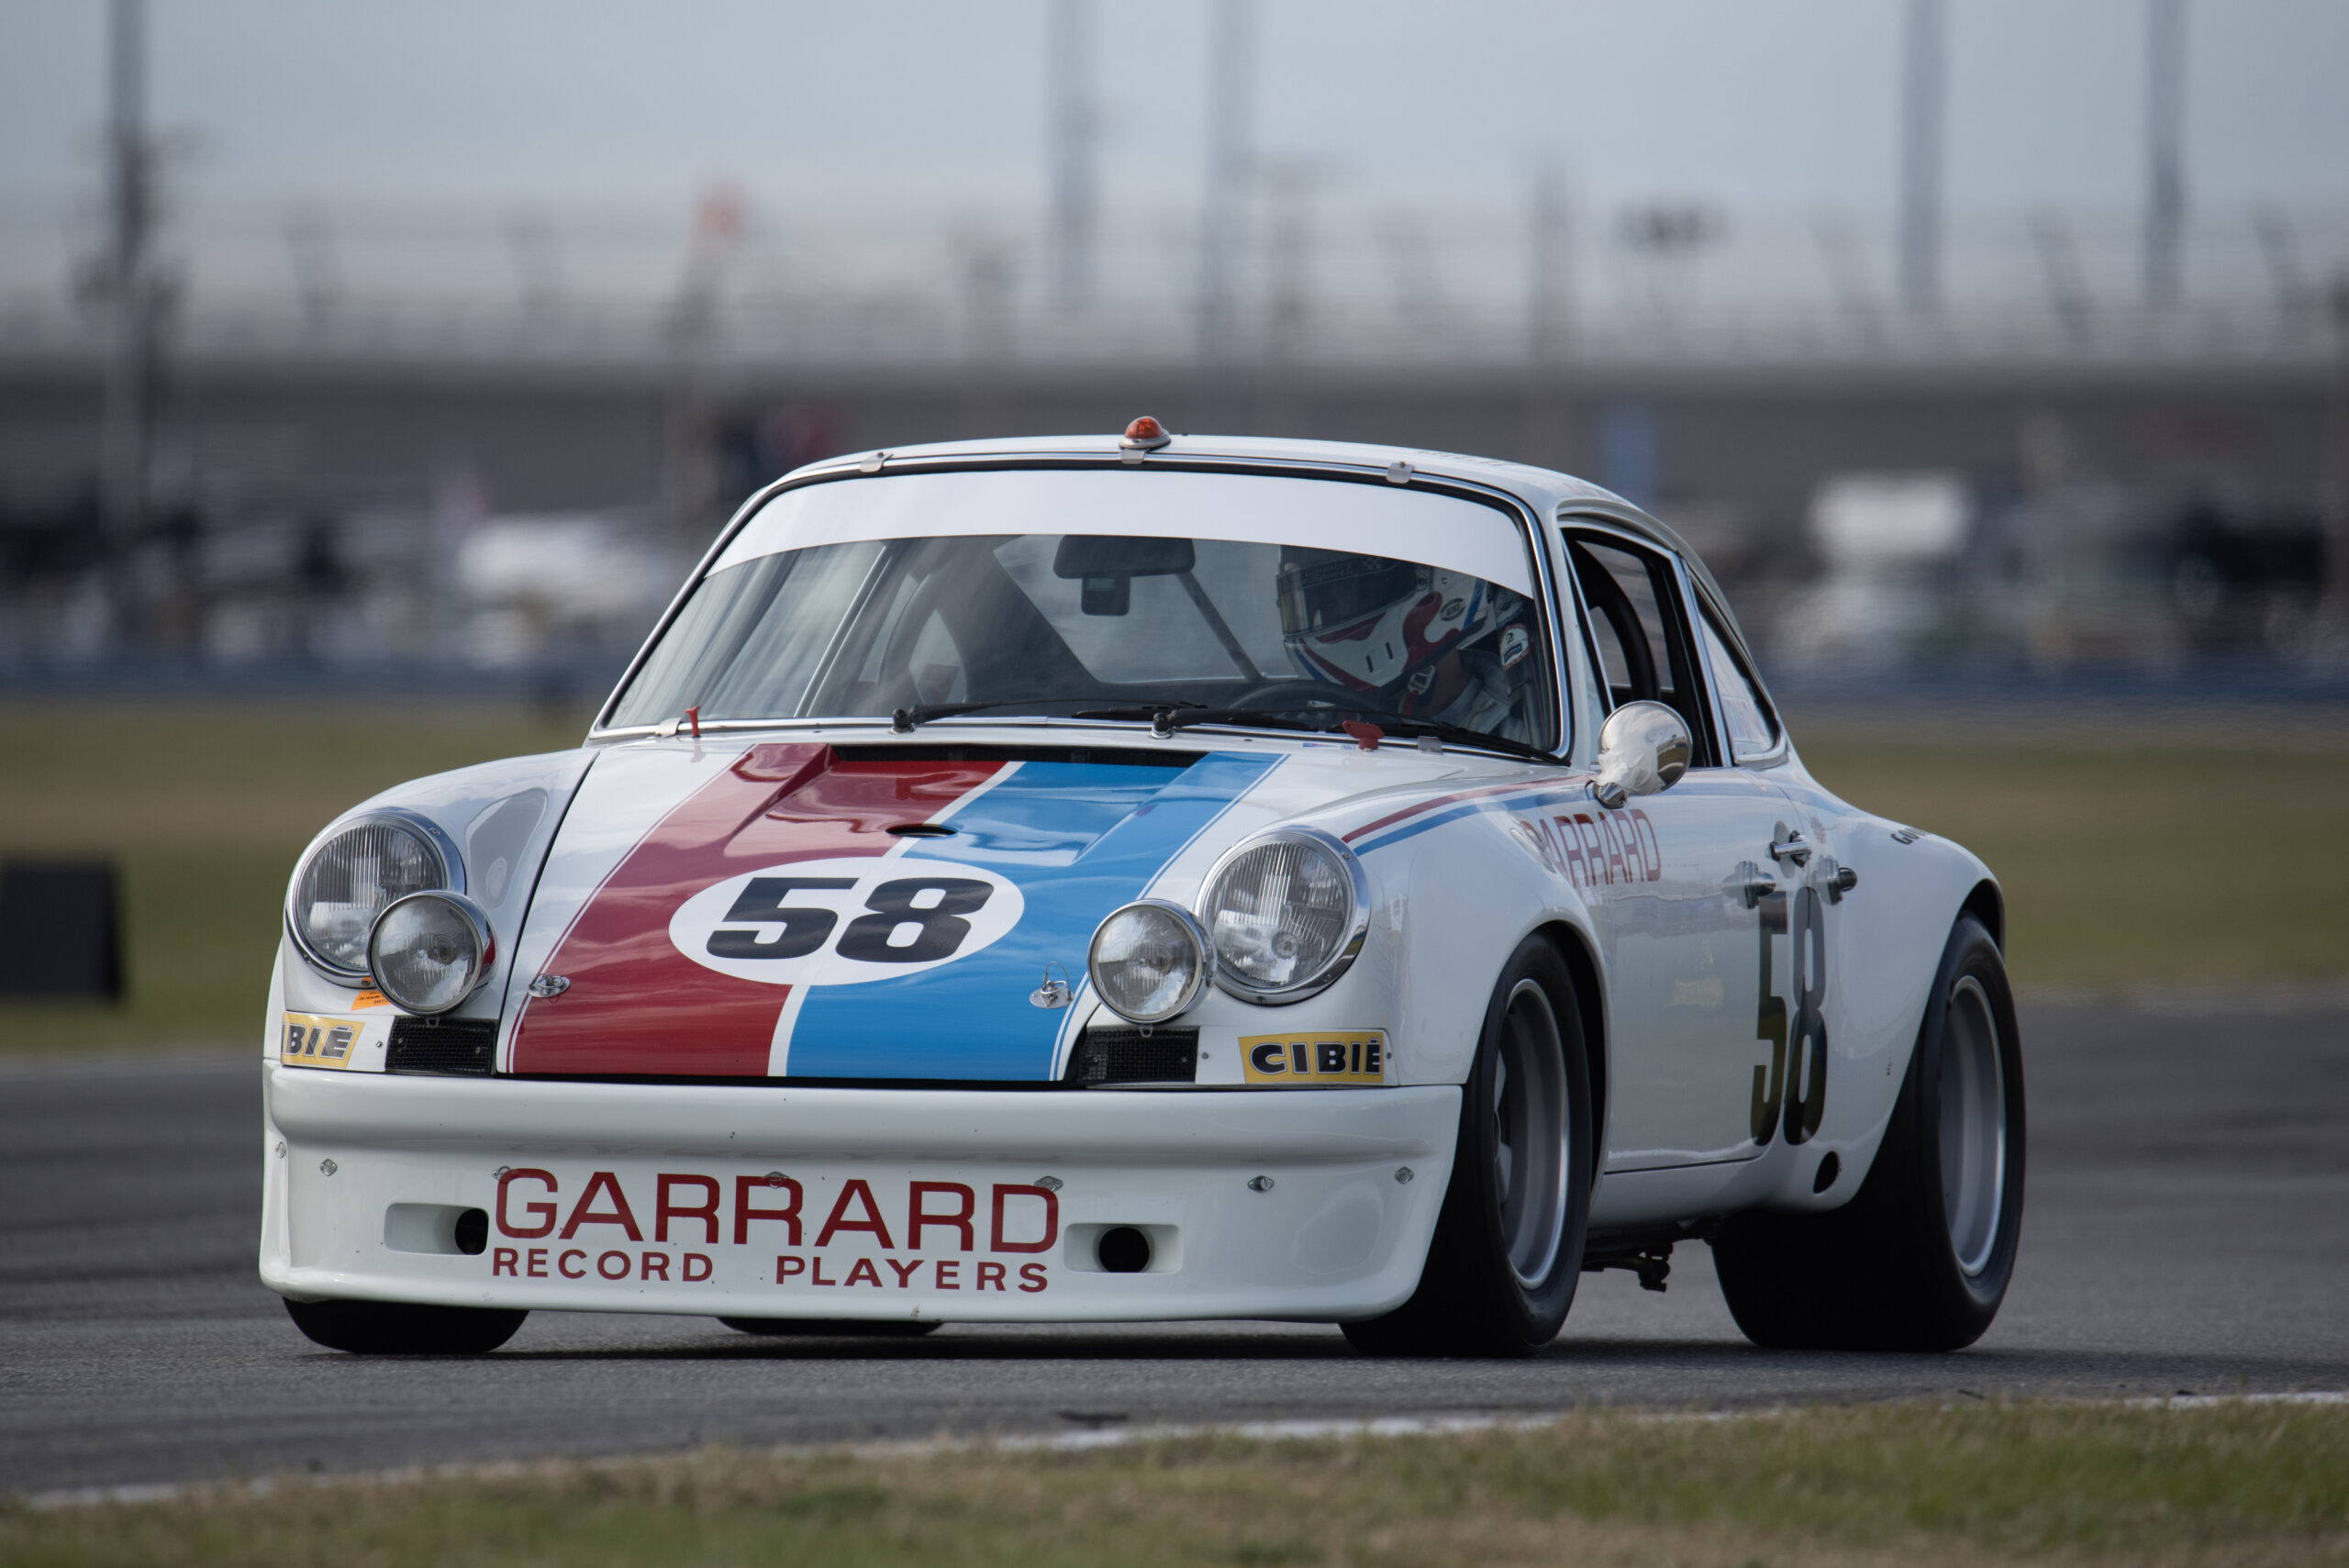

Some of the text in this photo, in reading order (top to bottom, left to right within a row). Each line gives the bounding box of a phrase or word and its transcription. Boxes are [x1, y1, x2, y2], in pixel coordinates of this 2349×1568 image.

[706, 877, 995, 963] 58
[1750, 885, 1828, 1147] 58
[495, 1167, 1059, 1254] GARRARD
[492, 1247, 1049, 1294] RECORD PLAYERS
